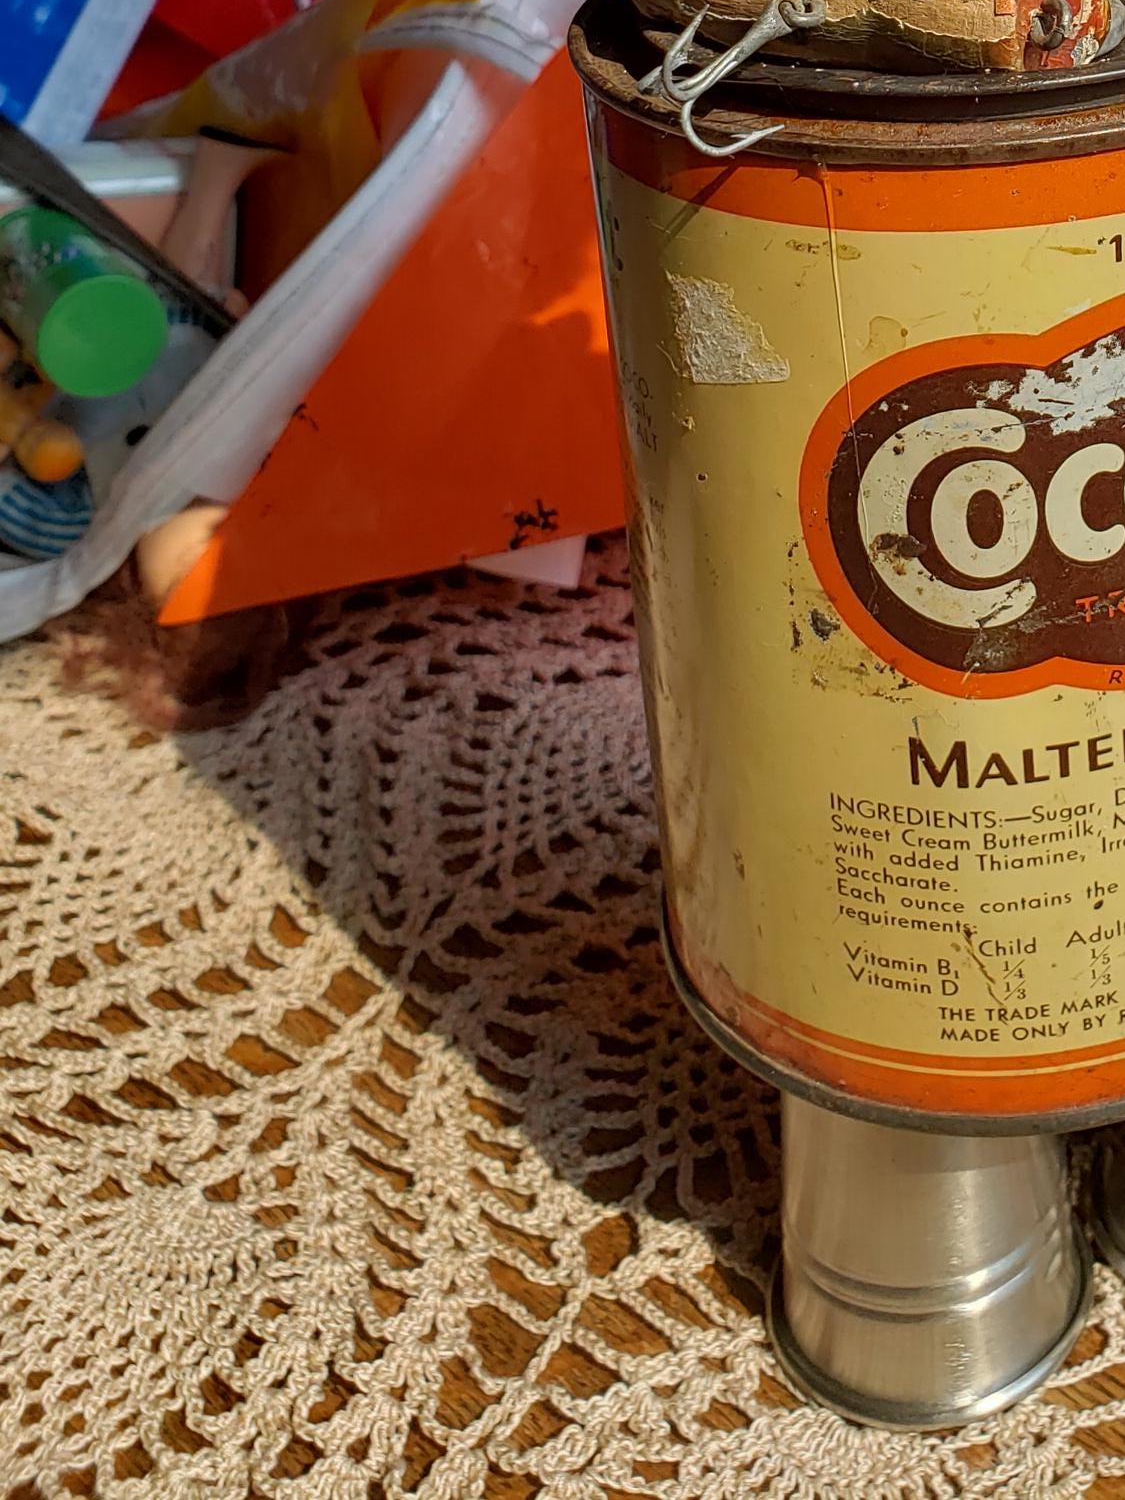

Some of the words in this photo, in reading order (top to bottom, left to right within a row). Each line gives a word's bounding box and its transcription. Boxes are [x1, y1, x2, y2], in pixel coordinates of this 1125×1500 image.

[1109, 235, 1124, 263] 1
[831, 814, 891, 842] Sweet
[902, 829, 970, 850] Cream
[983, 820, 1102, 850] Buttermilk,
[834, 841, 874, 861] with
[889, 851, 959, 871] added
[975, 850, 1086, 871] Thiamine,
[835, 857, 958, 893] Saccharate.
[837, 877, 886, 905] Each
[901, 896, 964, 913] ounce
[980, 891, 1072, 914] contains
[1086, 881, 1119, 899] the
[839, 905, 978, 934] requirements:
[843, 941, 928, 974] Vitamin
[979, 937, 1037, 957] Child
[847, 963, 932, 995] Vitamin
[942, 979, 959, 996] D
[938, 1006, 976, 1021] THE
[985, 1003, 1050, 1022] TRADE
[1060, 990, 1119, 1015] MARK
[940, 1027, 1000, 1042] MADE
[1012, 1021, 1069, 1041] ONLY
[1083, 1014, 1106, 1031] BY
